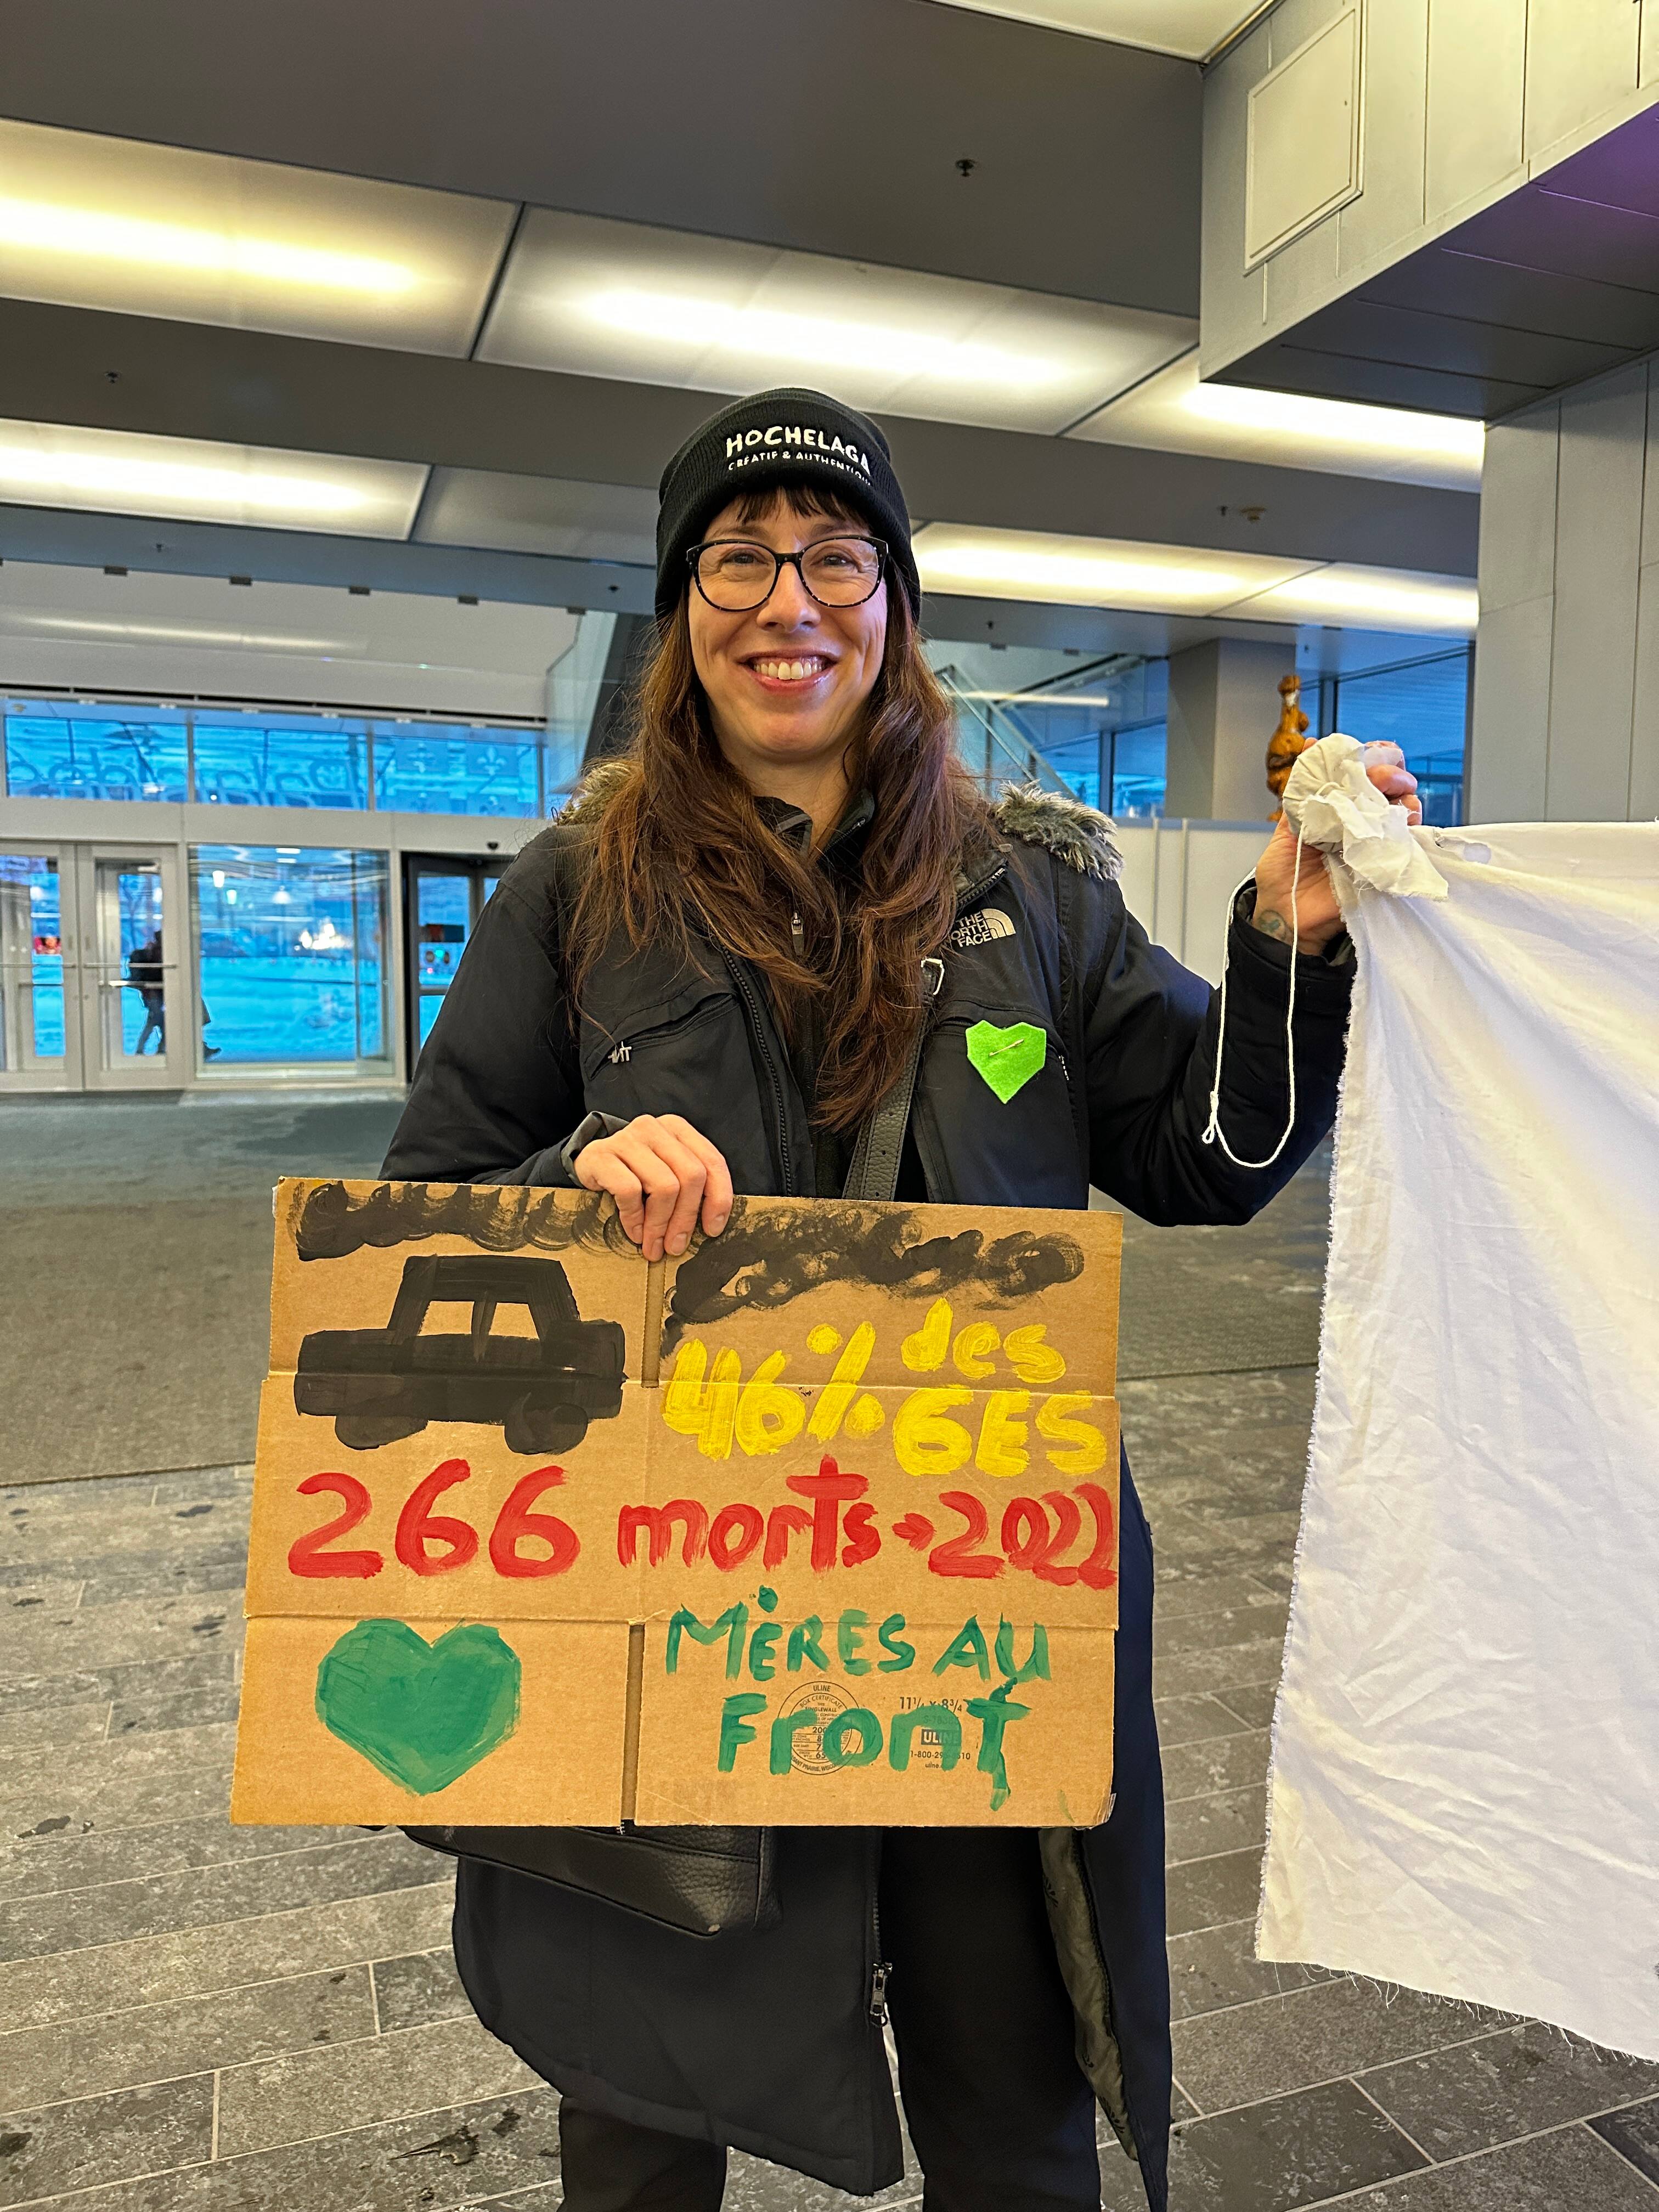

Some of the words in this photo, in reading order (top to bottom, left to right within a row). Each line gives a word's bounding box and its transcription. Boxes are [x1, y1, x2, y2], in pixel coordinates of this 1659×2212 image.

[726, 426, 871, 476] HOCHELAGA
[782, 450, 791, 460] &
[956, 911, 984, 927] THE
[950, 920, 989, 940] ORTH
[957, 929, 992, 948] FACE
[662, 1321, 885, 1462] 46%
[900, 1296, 1066, 1384] des
[288, 1458, 581, 1579] 266
[618, 1454, 881, 1574] morts
[932, 1612, 1051, 1681] AU
[799, 1698, 811, 1708] BOX
[812, 1694, 844, 1710] CERTIFICATE
